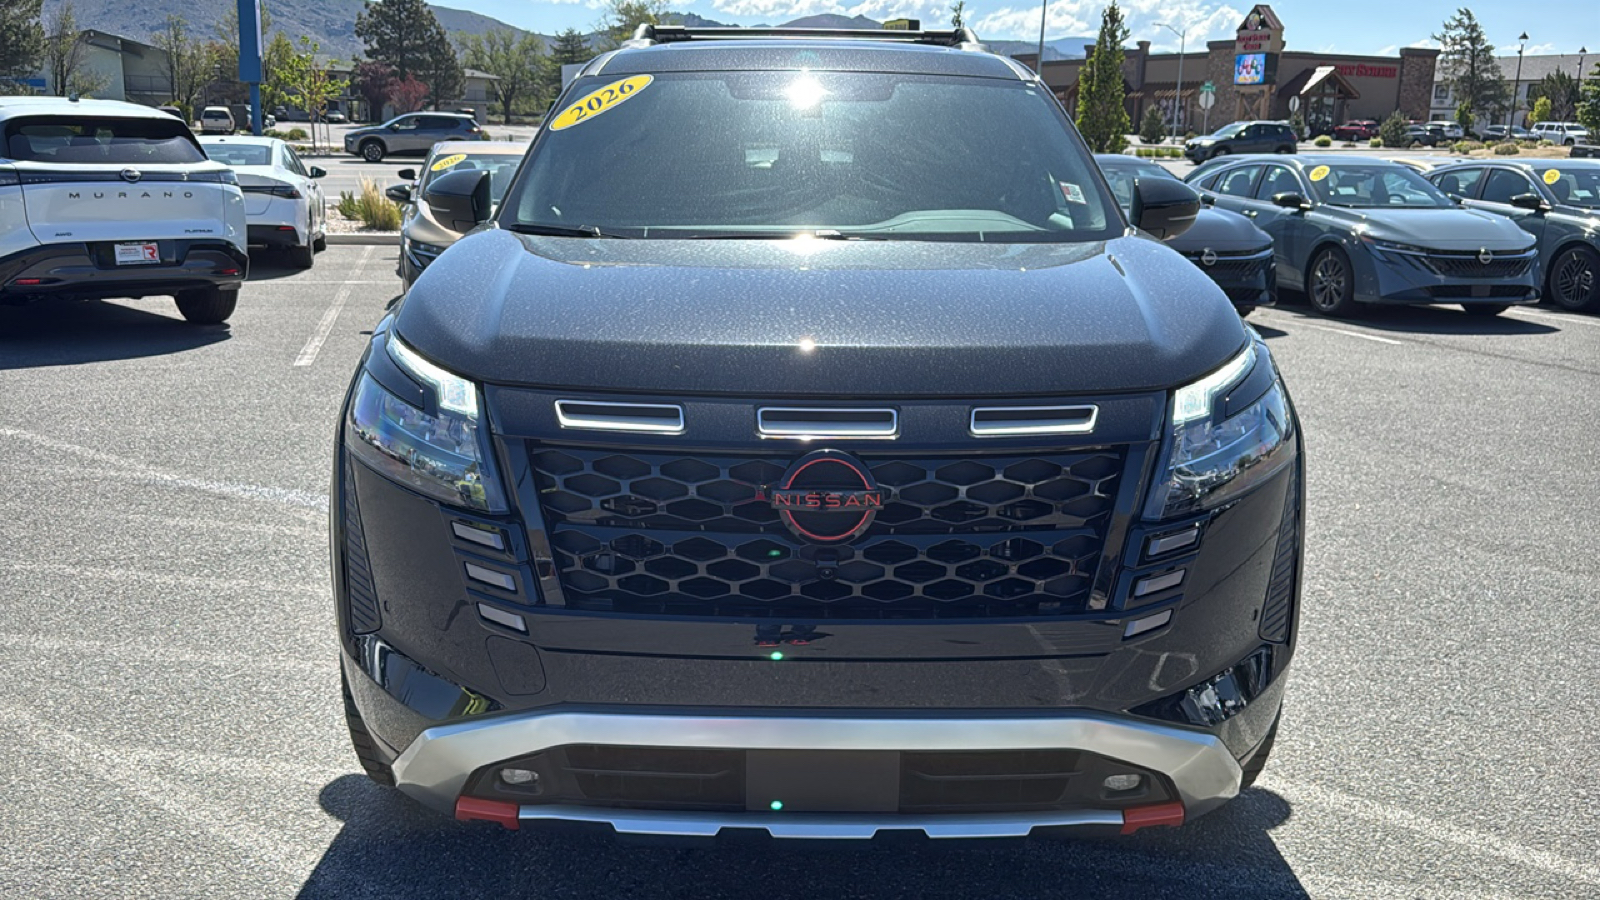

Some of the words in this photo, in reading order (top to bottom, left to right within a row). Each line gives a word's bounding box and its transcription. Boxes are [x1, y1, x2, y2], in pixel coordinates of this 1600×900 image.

[570, 79, 635, 121] 2026
[68, 191, 193, 199] MURANO
[775, 493, 881, 508] NISSAN
